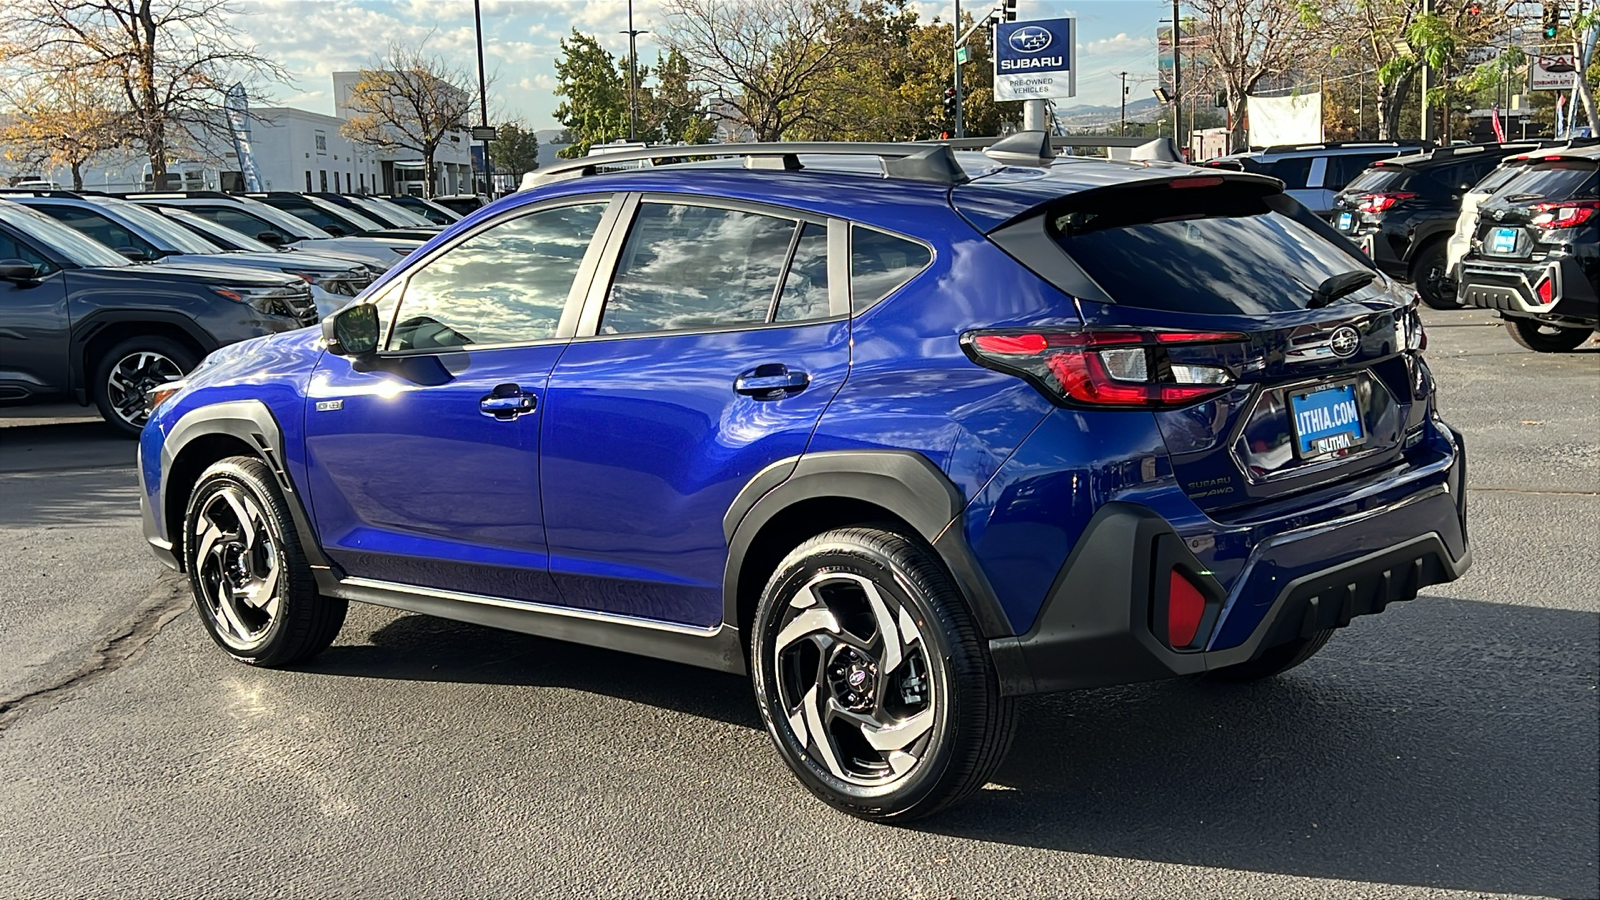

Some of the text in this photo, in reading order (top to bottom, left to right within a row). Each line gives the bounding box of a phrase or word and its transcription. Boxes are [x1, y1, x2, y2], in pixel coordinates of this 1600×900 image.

[1001, 56, 1062, 69] SUBARU
[1009, 78, 1053, 86] PRE-OWNED
[1013, 86, 1049, 94] VEHICLES
[1295, 400, 1358, 436] LITHIA.COM
[1325, 433, 1351, 451] LITHIA
[1187, 476, 1231, 489] SUBARU
[1207, 486, 1234, 497] AWD
